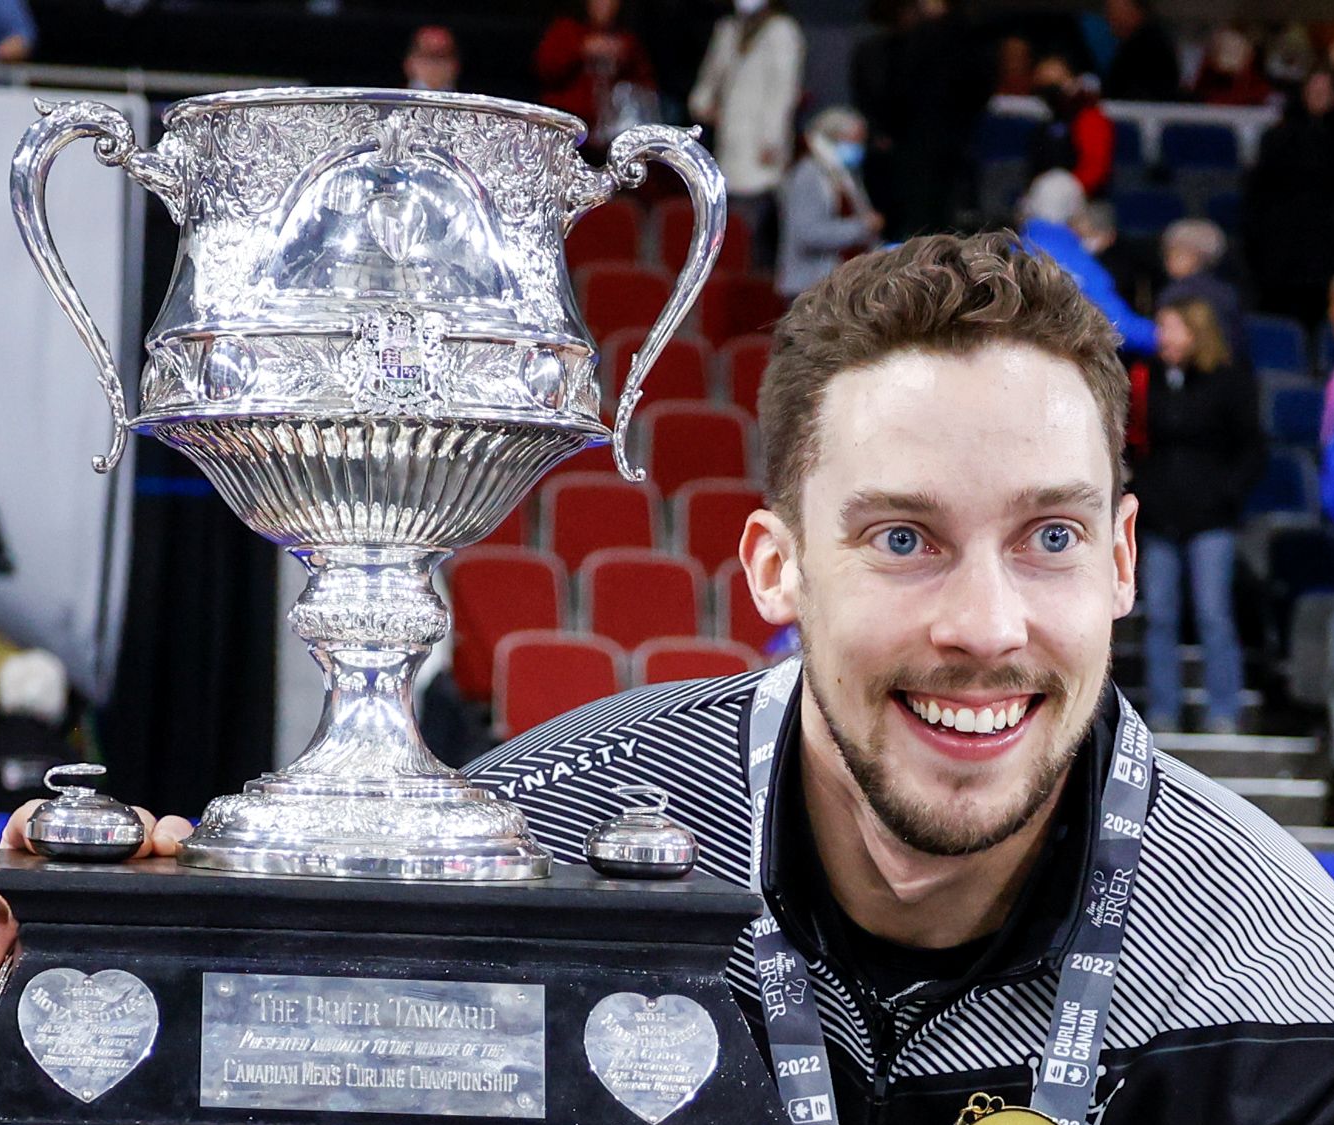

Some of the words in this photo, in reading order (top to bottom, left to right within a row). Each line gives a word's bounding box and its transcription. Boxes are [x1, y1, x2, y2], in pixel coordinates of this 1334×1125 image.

[750, 741, 775, 769] 2022
[1103, 812, 1142, 840] 2022
[1104, 868, 1133, 928] BRIER
[753, 915, 781, 939] 202
[1070, 953, 1115, 977] 2022
[758, 959, 787, 1022] BRIER
[253, 994, 299, 1024] THE
[388, 998, 497, 1030] TANKARD
[1055, 1000, 1081, 1058] CURLING
[1072, 1008, 1099, 1061] CANADA
[223, 1059, 299, 1085] CANADIAN
[345, 1063, 406, 1089] CURLING
[409, 1065, 519, 1093] CHAMPIONSHIP
[777, 1055, 821, 1078] 2022
